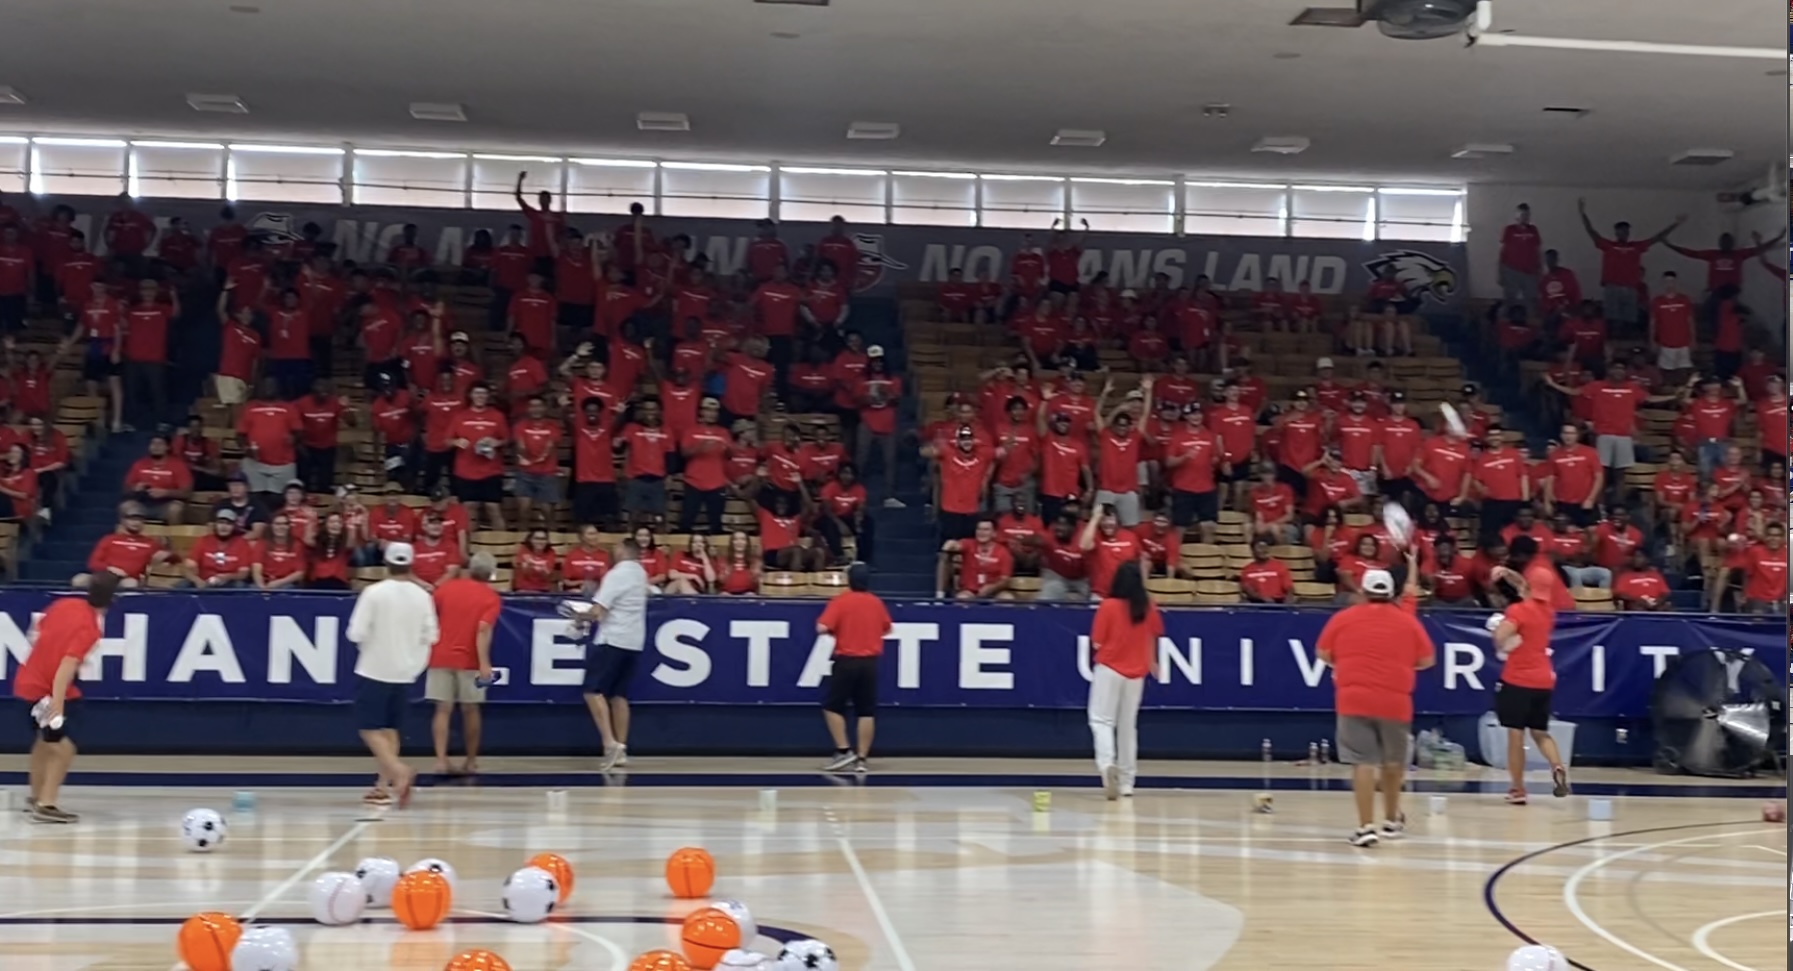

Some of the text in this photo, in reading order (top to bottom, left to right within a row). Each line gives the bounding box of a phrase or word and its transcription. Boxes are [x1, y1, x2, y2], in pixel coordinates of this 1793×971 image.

[919, 243, 1347, 294] NO ANS LAND
[0, 610, 587, 686] NHANE
[1077, 634, 1756, 694] NIVRITY
